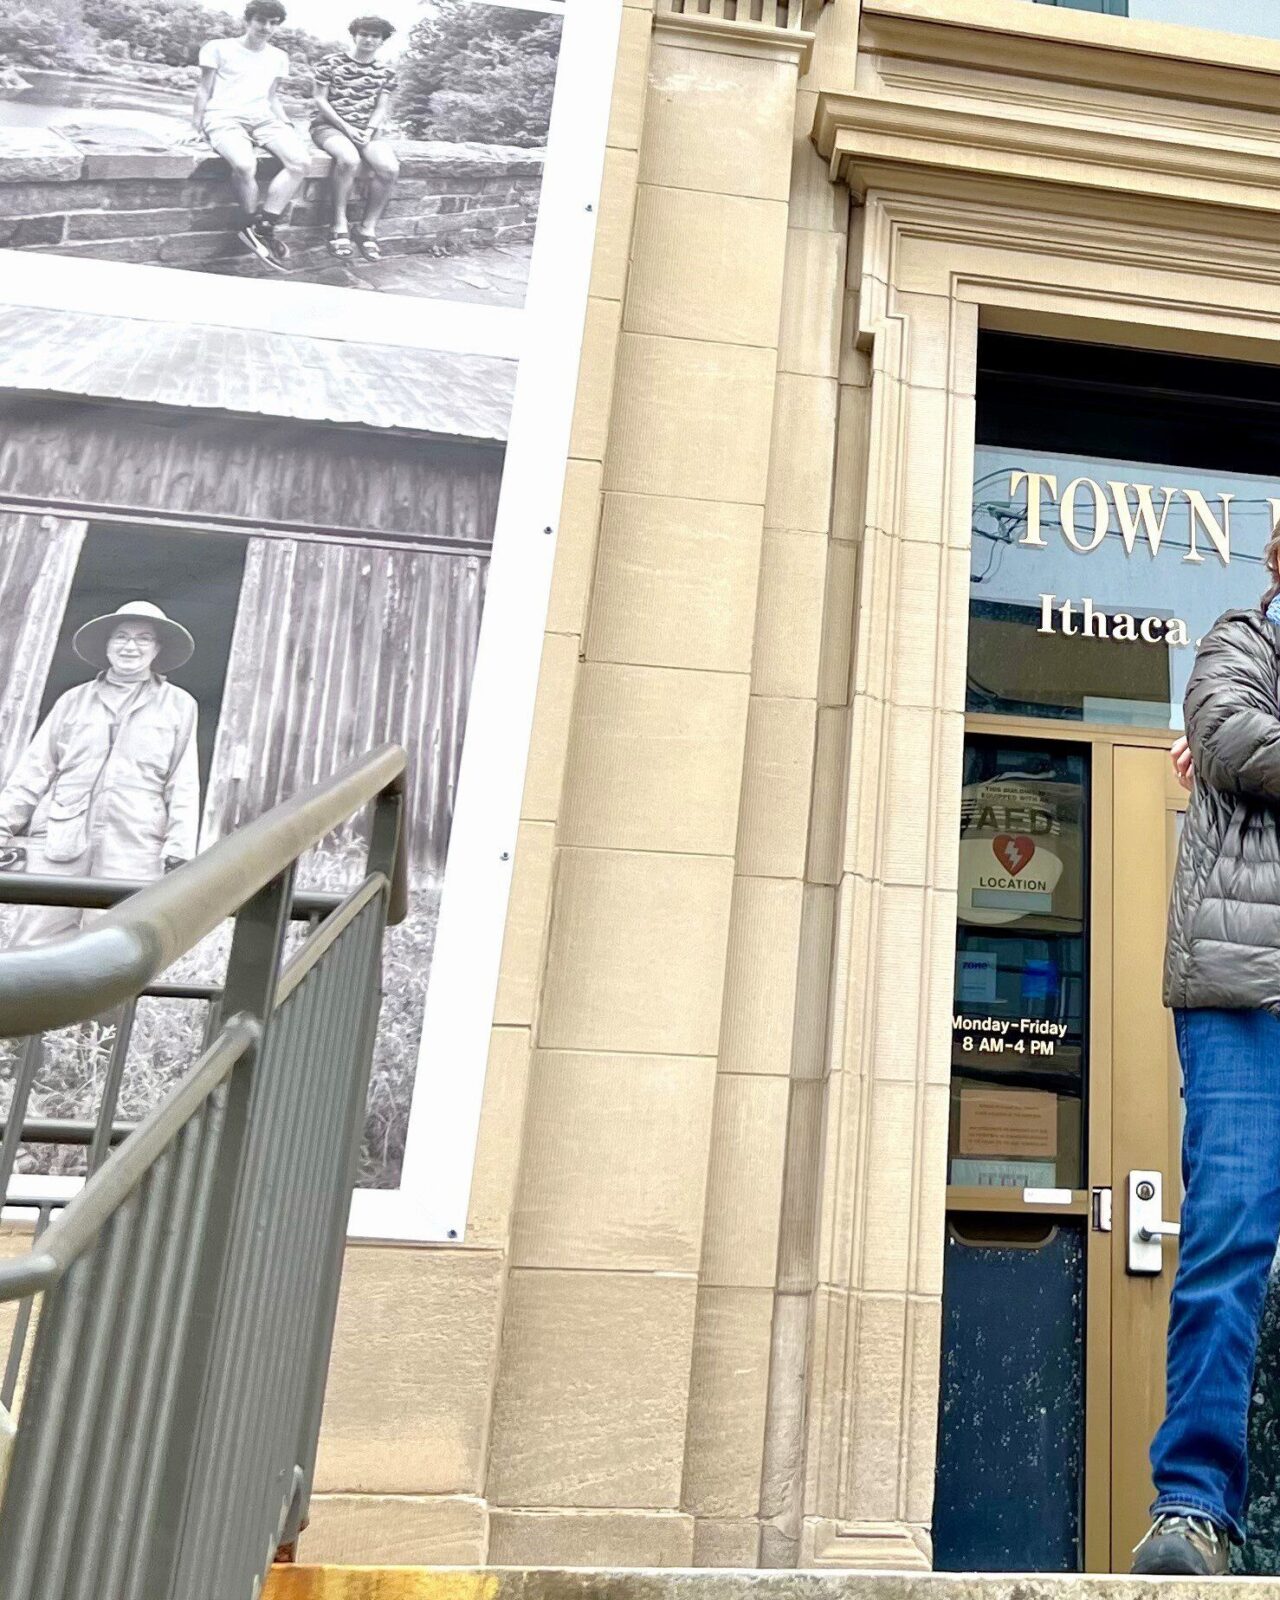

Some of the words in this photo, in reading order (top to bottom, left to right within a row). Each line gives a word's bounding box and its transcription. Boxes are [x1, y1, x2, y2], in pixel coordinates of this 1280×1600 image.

[1010, 470, 1235, 564] TOWN
[976, 805, 1053, 835] AED
[979, 876, 1047, 891] LOCATION
[962, 1036, 974, 1051] 8
[1030, 1039, 1054, 1056] PM
